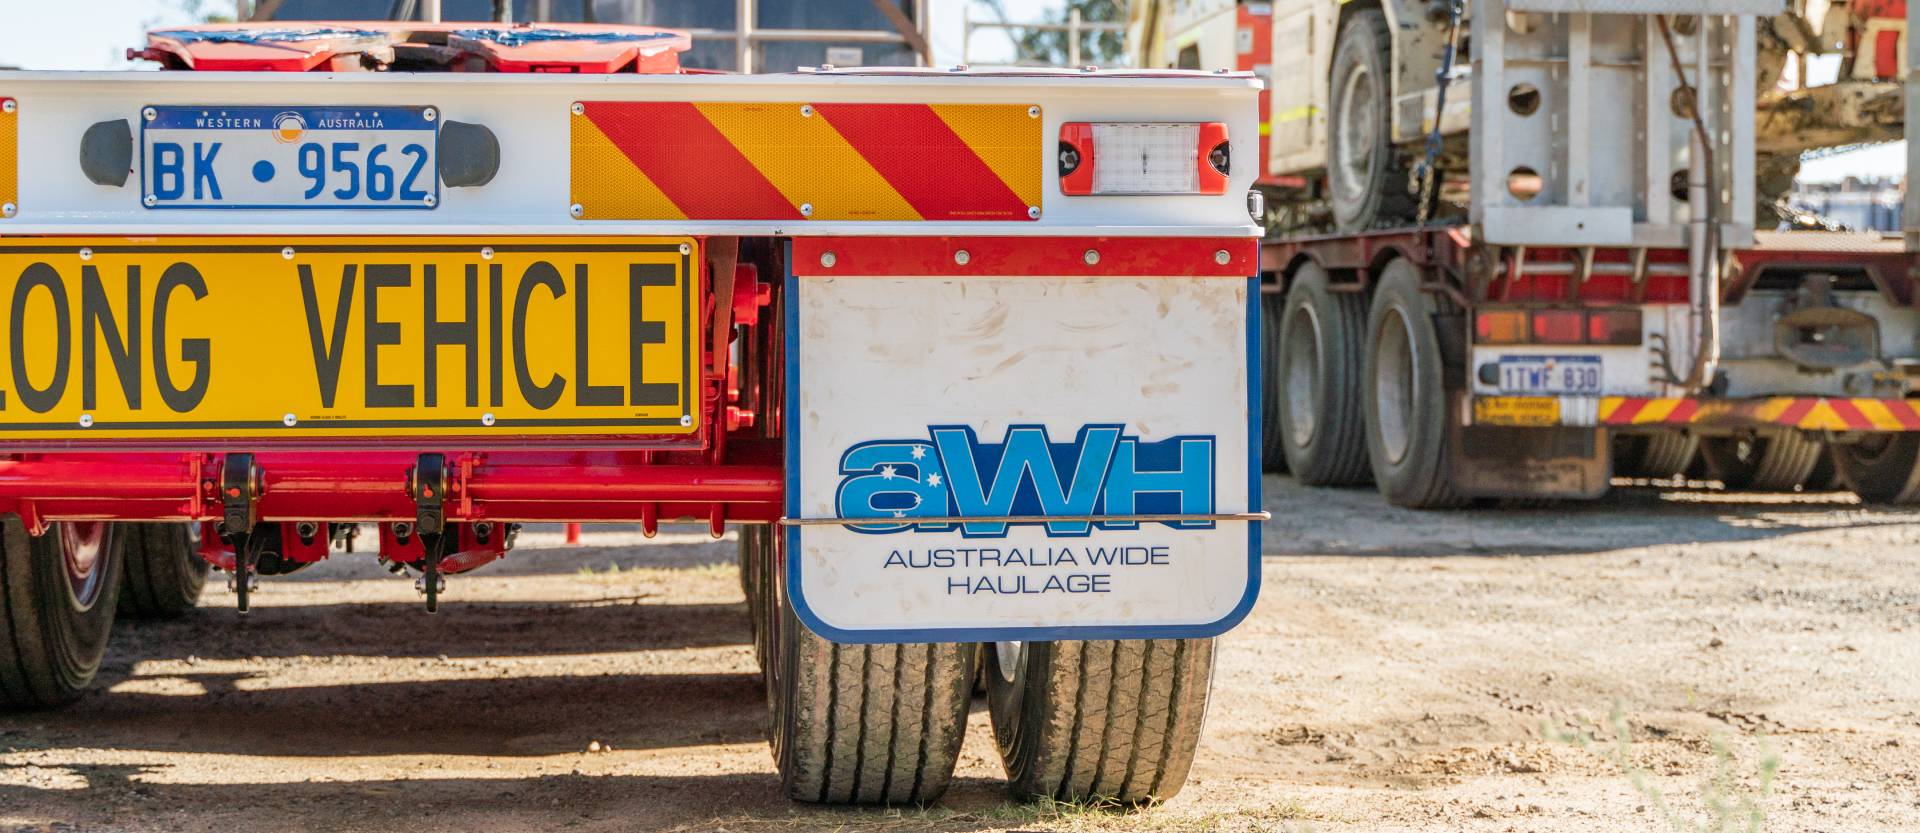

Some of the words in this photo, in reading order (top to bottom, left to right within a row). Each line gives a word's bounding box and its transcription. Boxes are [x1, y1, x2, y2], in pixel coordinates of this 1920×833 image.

[196, 118, 262, 128] WESTERN
[318, 118, 384, 129] AUSTRALIA
[153, 142, 223, 200] BK
[298, 142, 428, 200] 9562
[0, 262, 211, 413] ONG
[298, 261, 680, 410] VEHICLE
[1563, 366, 1597, 390] 830
[883, 547, 1078, 569] AUSTRALIA
[1084, 545, 1170, 566] WIDE
[947, 574, 1112, 595] HAULAGE
